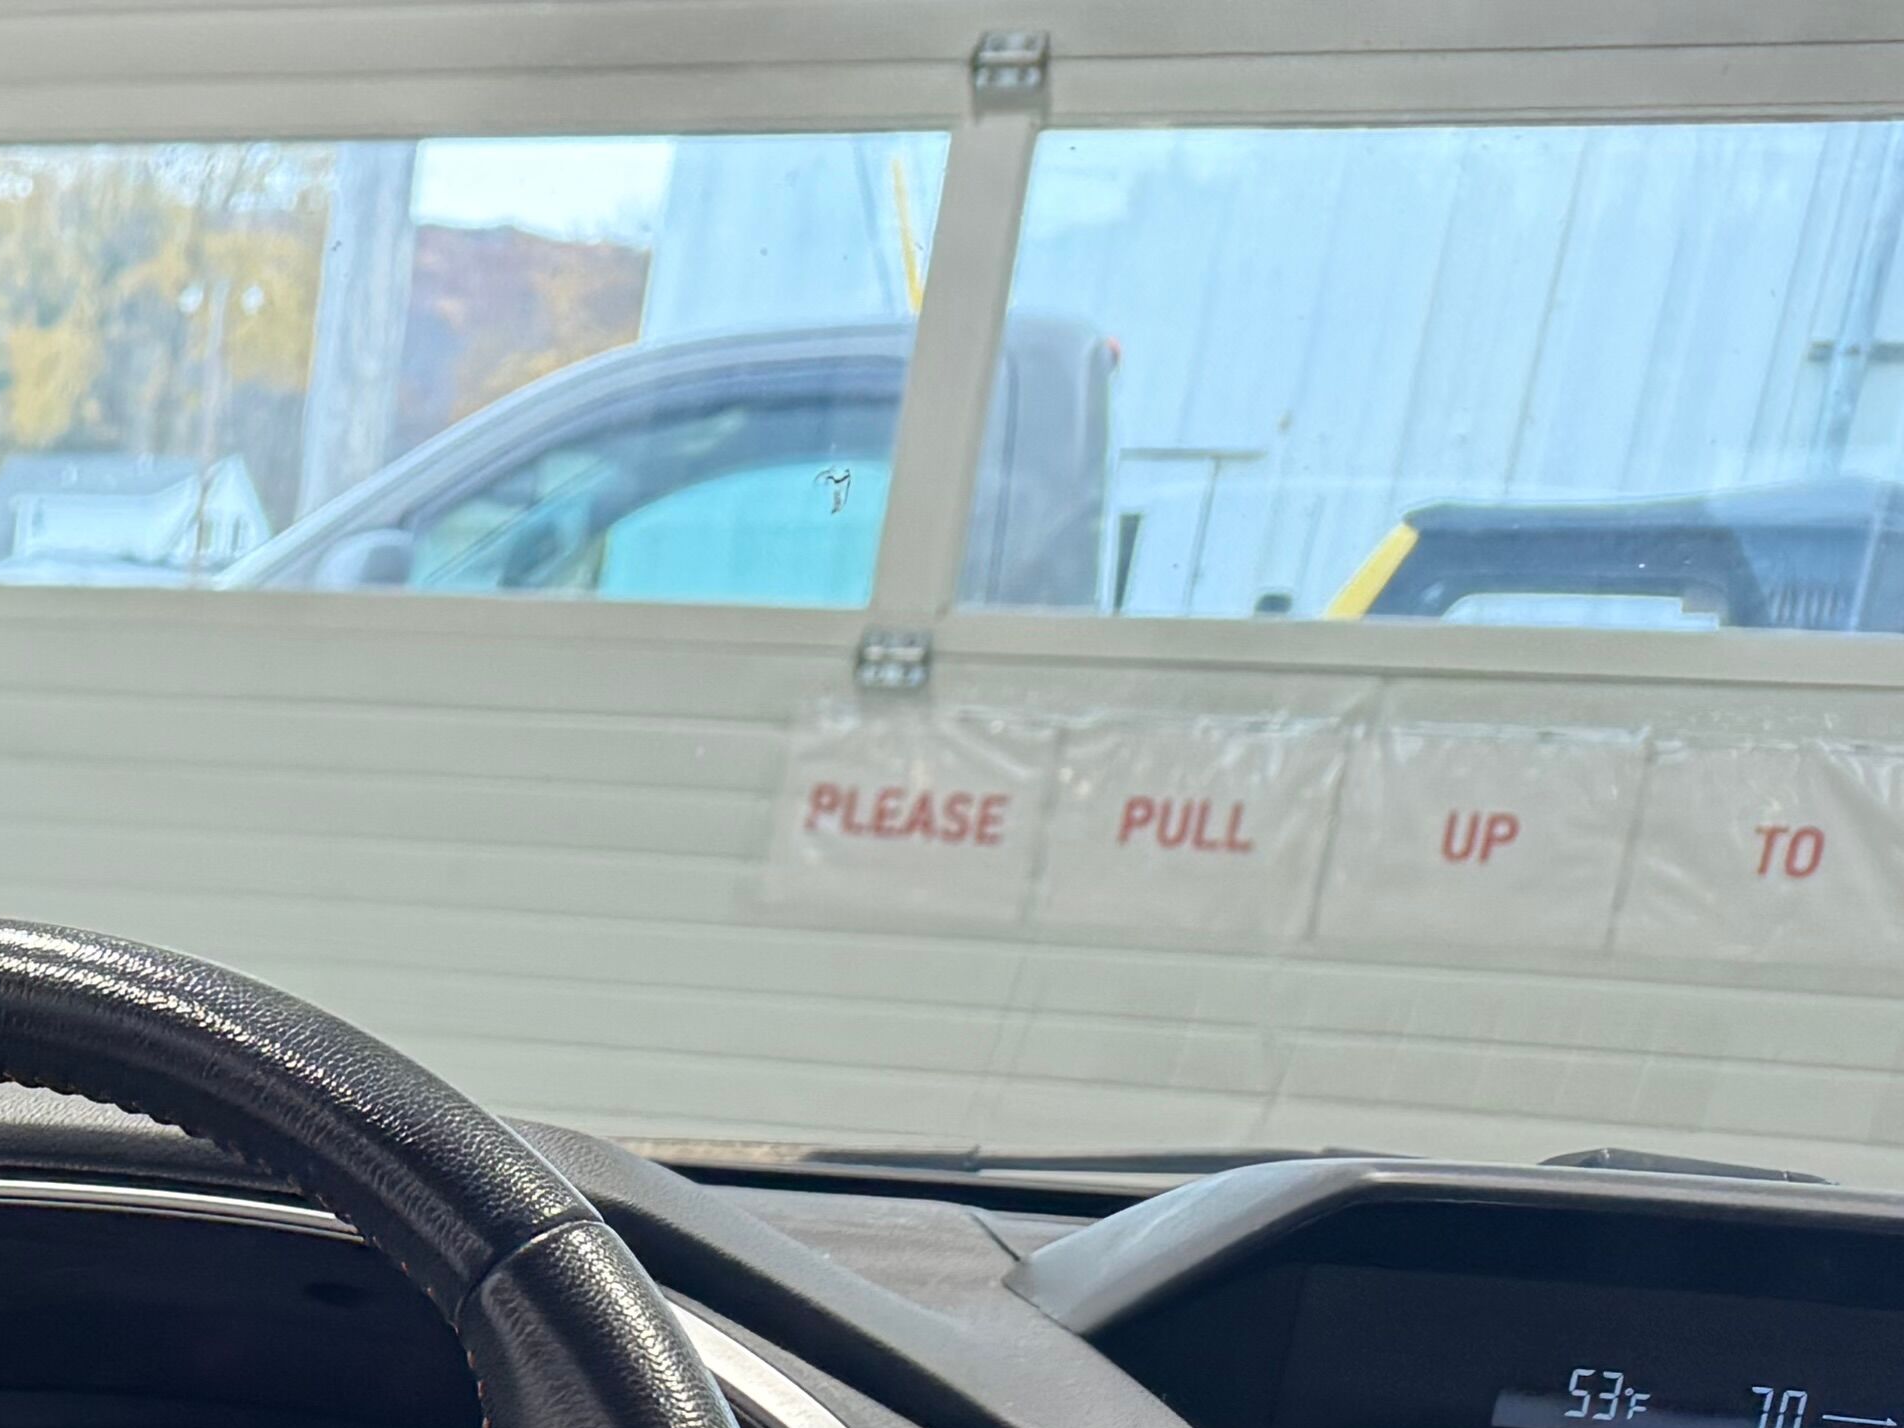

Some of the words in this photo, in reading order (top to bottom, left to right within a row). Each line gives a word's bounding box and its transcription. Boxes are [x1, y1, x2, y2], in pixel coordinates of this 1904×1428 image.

[804, 783, 1010, 848] PLEASE
[1117, 797, 1255, 853] PULL
[1441, 811, 1521, 864] UP
[1752, 824, 1825, 879] TO
